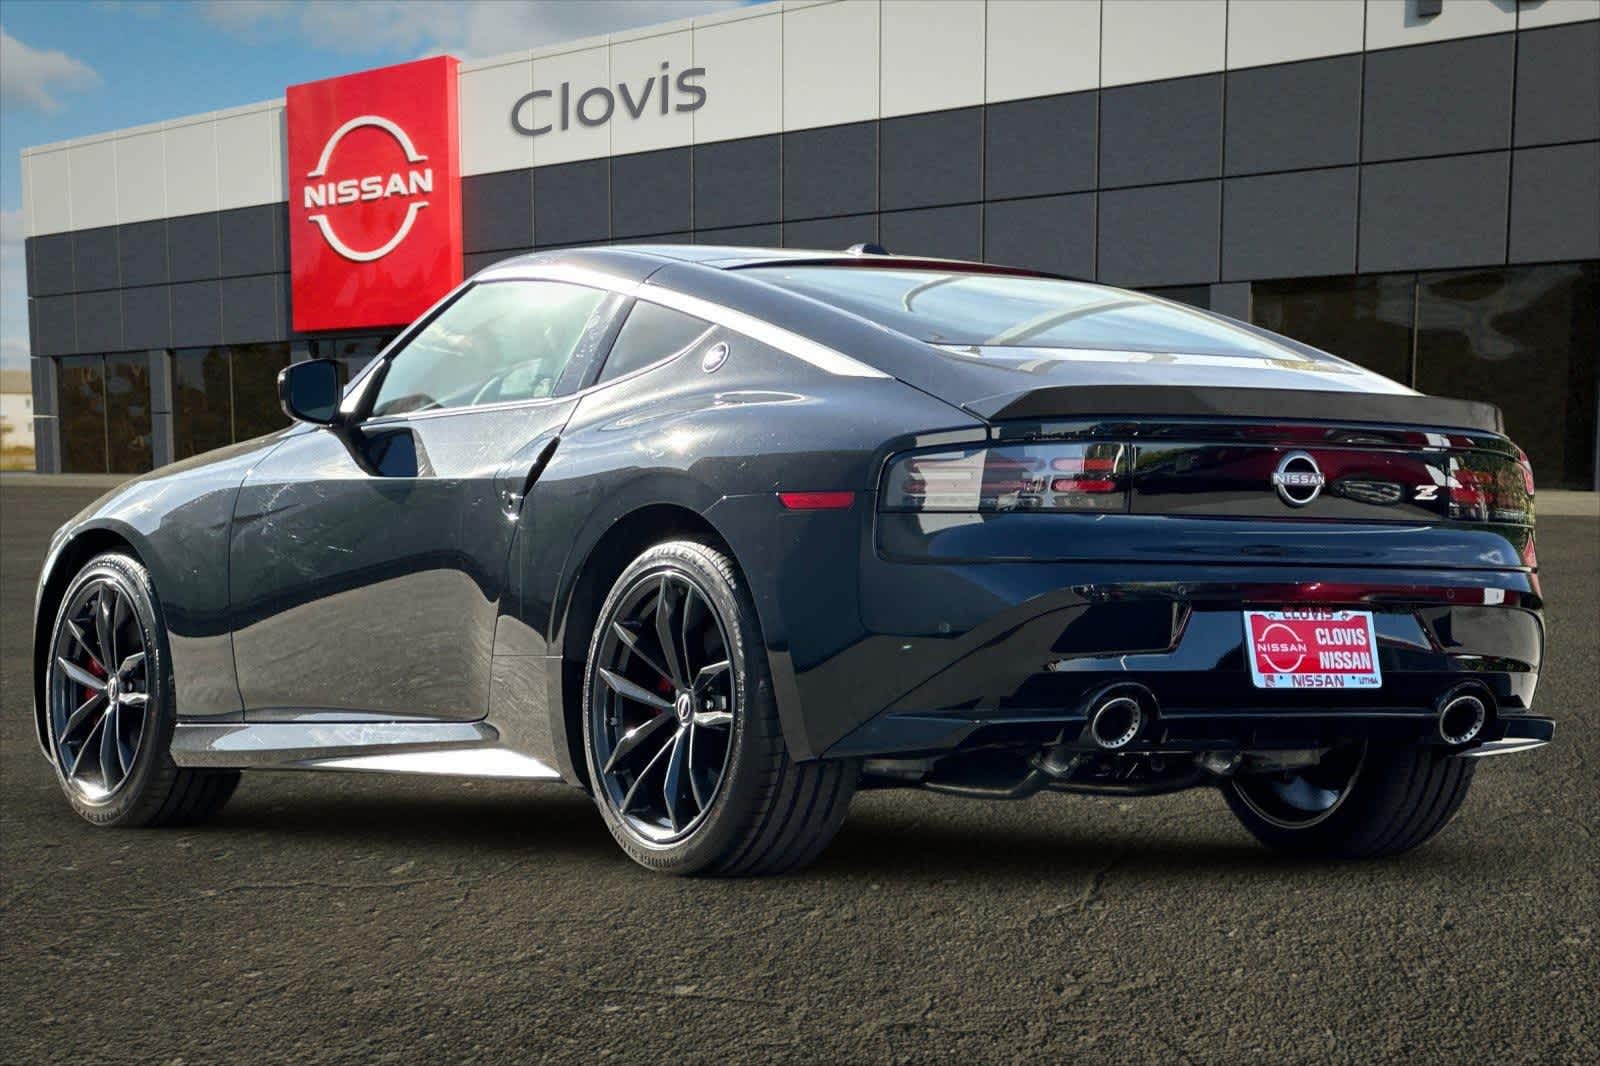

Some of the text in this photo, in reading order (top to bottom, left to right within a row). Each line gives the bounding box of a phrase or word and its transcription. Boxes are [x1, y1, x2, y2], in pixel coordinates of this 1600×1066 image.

[304, 168, 433, 208] NISSAN
[1273, 472, 1325, 485] NISSAN
[1415, 485, 1438, 500] Z
[1315, 628, 1366, 646] CLOVIS
[1257, 643, 1306, 652] NISSAN
[1319, 652, 1371, 669] NISSAN
[1291, 675, 1345, 687] NISSAN
